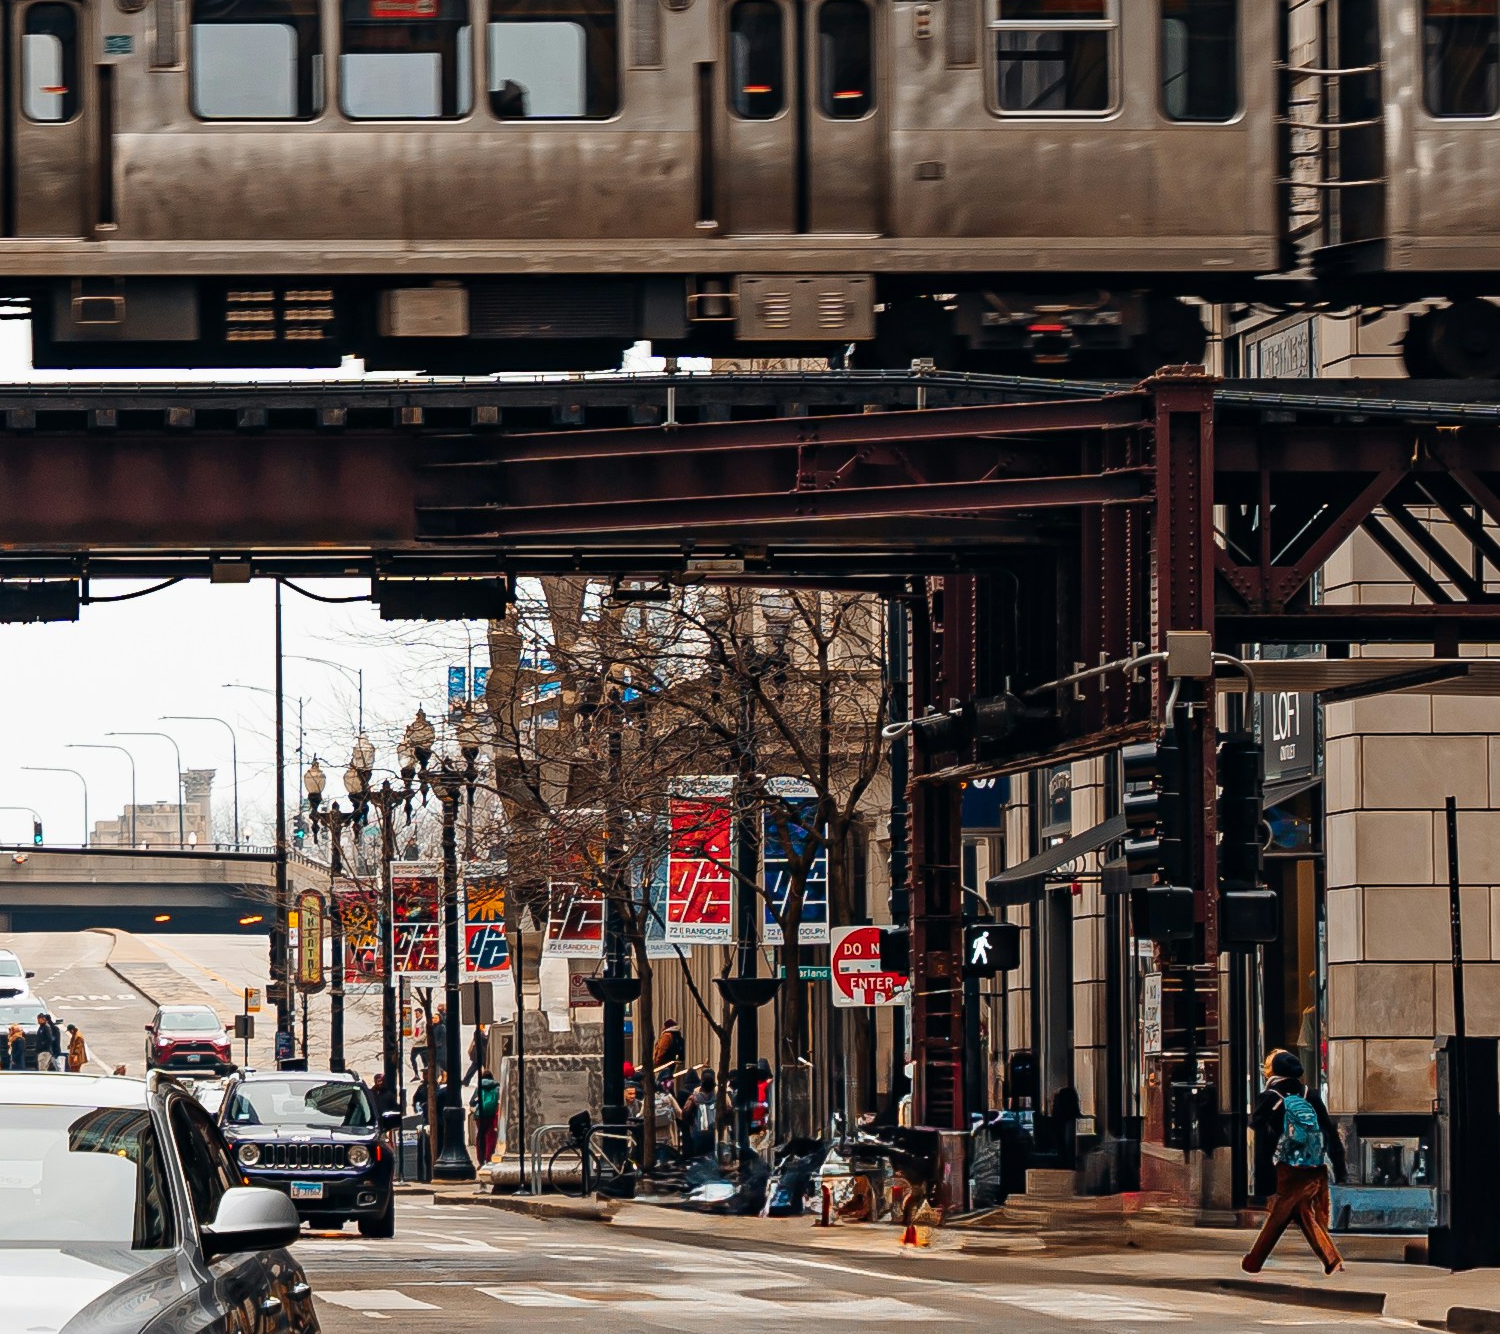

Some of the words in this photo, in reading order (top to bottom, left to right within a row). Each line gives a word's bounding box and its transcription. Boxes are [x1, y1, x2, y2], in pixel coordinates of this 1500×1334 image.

[1272, 691, 1300, 741] LOFT
[844, 943, 862, 955] DO
[799, 969, 828, 977] arland
[850, 977, 894, 989] ENTER
